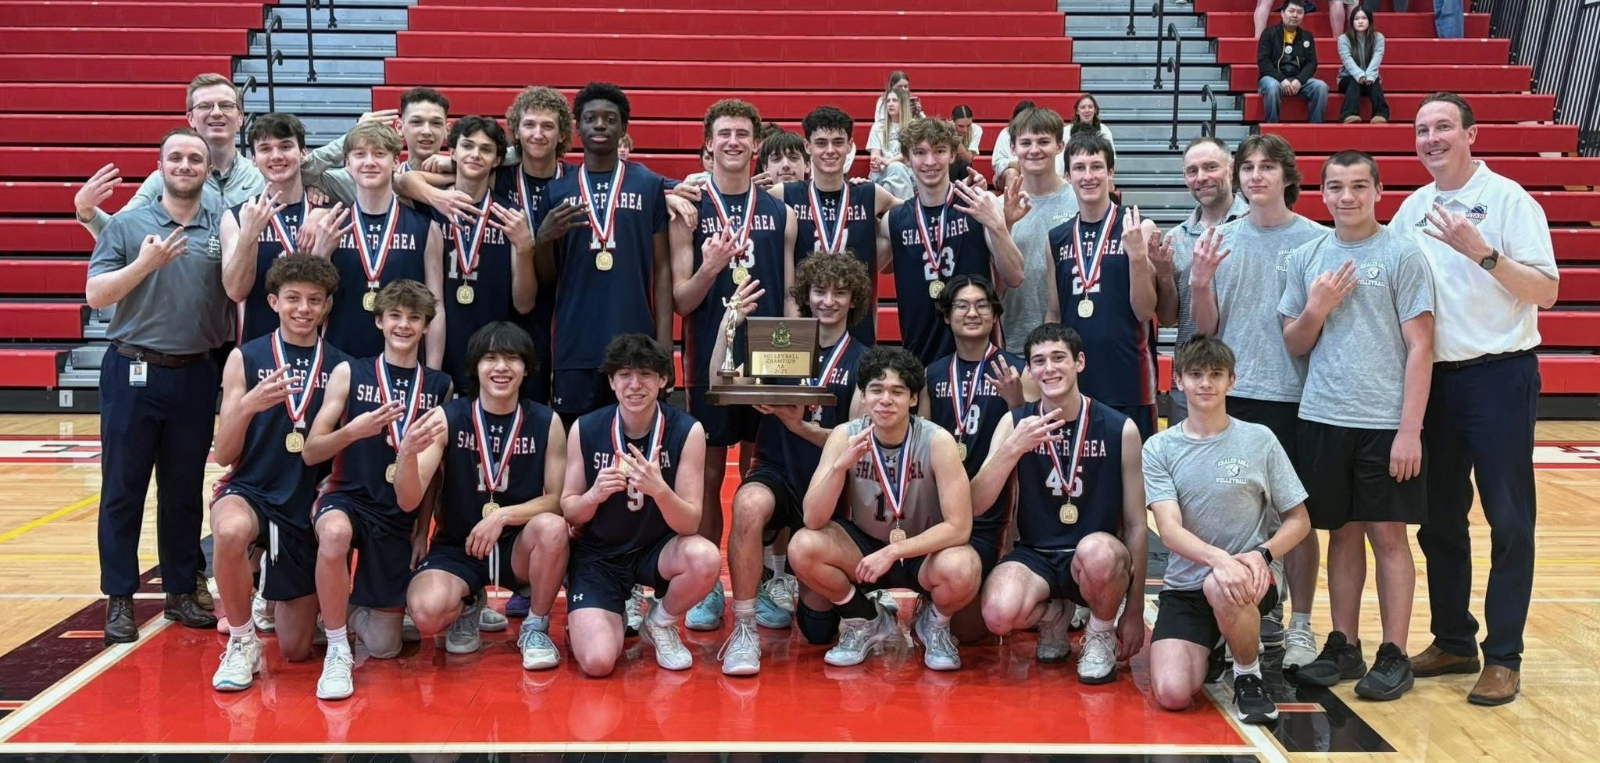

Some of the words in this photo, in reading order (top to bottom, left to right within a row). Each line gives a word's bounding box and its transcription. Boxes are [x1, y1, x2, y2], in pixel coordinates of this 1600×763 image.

[794, 203, 836, 221] SHAER
[848, 204, 867, 221] REA
[701, 214, 742, 234] SHAER
[483, 228, 505, 245] REA
[1102, 239, 1124, 255] REA
[922, 246, 956, 281] 23
[829, 368, 849, 386] REA
[976, 379, 1001, 397] ARE
[954, 404, 980, 436] 8
[513, 436, 536, 454] REA
[1081, 440, 1107, 457] REA
[1045, 466, 1083, 498] 45
[626, 478, 644, 512] 9
